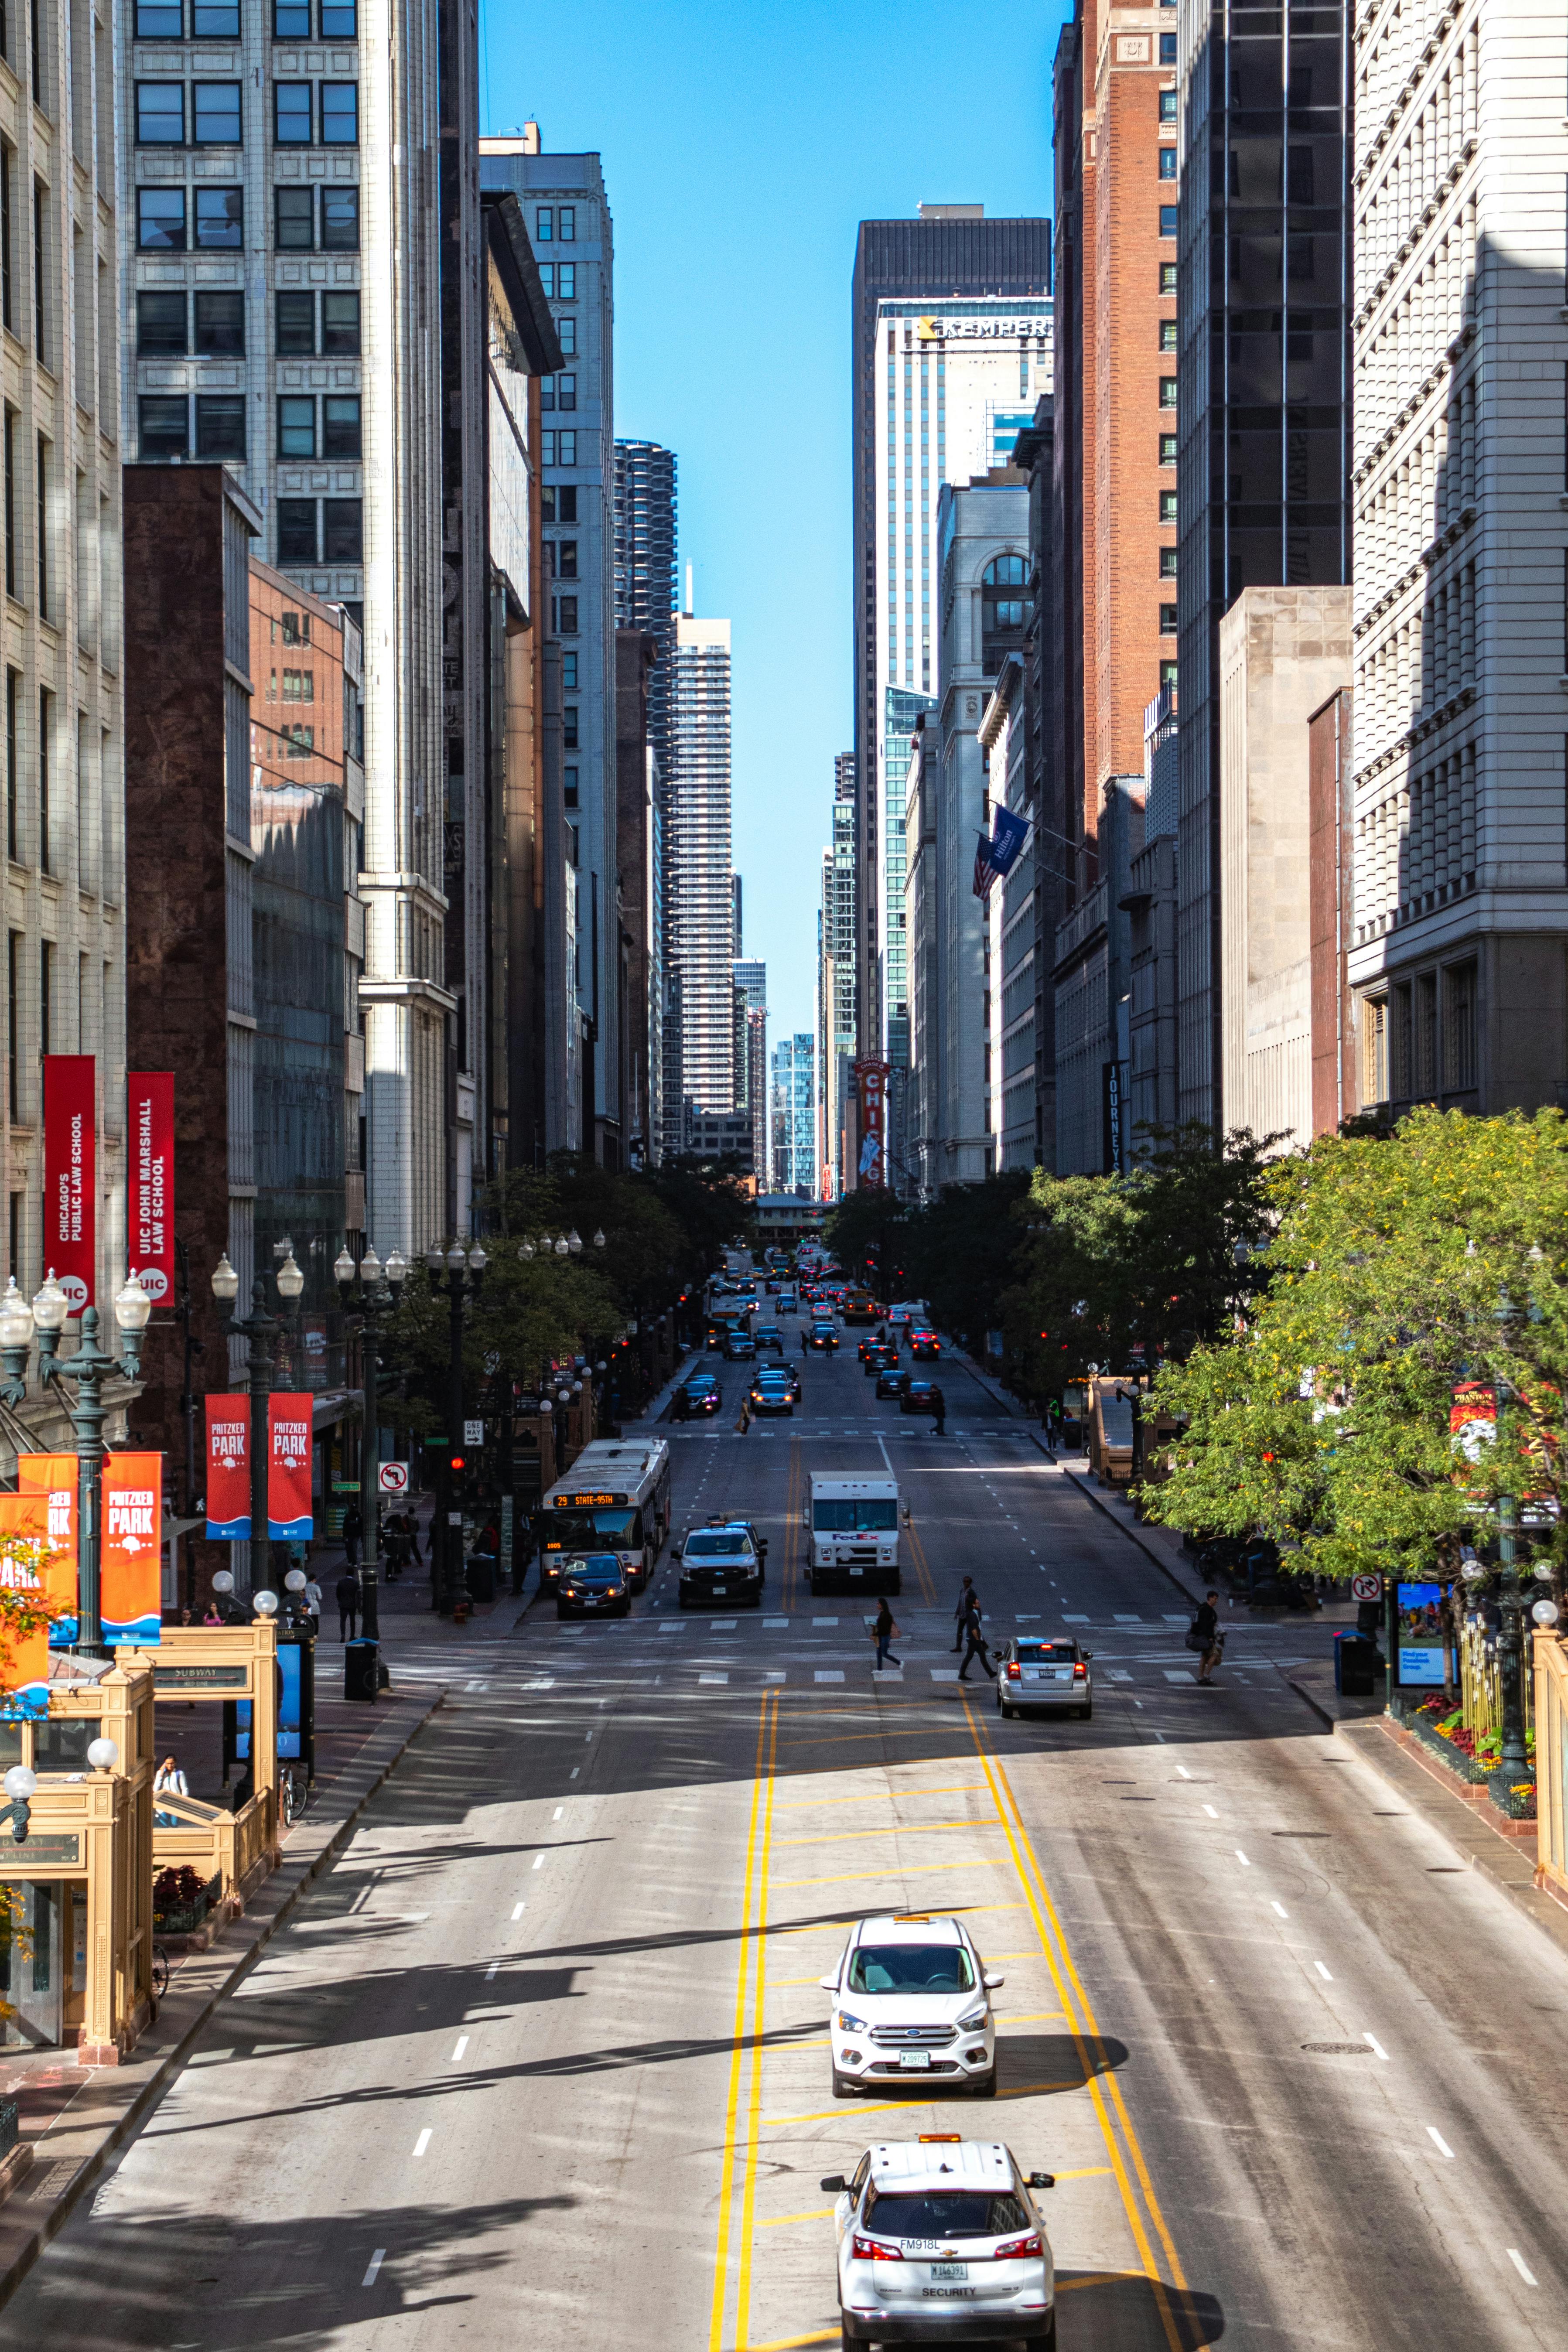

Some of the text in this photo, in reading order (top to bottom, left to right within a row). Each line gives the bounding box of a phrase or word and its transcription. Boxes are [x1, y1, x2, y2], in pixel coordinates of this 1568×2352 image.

[943, 317, 1049, 336] KEMPER
[994, 829, 1013, 859] Hilton
[1110, 1065, 1120, 1171] JOURNEYS
[72, 1113, 82, 1241] PUBLIC LAW SCHOOL
[140, 1099, 151, 1254] UIC JOHN MARSHALL
[59, 1173, 69, 1242] CHICAGO'S
[152, 1156, 164, 1254] LAW SCHOOL
[140, 1278, 165, 1290] UIC
[212, 1423, 245, 1435] PRITZKER
[274, 1422, 307, 1434] PRITZKER
[212, 1435, 245, 1456] PARK
[274, 1435, 306, 1455] PARK
[109, 1491, 154, 1506] PRITZKER
[558, 1495, 613, 1506] 29 STATE-95TH
[109, 1508, 153, 1534] PARK
[175, 1668, 217, 1677] SUBWAY
[900, 2239, 940, 2250] FM918L
[938, 2265, 964, 2276] 146391
[922, 2287, 977, 2297] SECURITY
